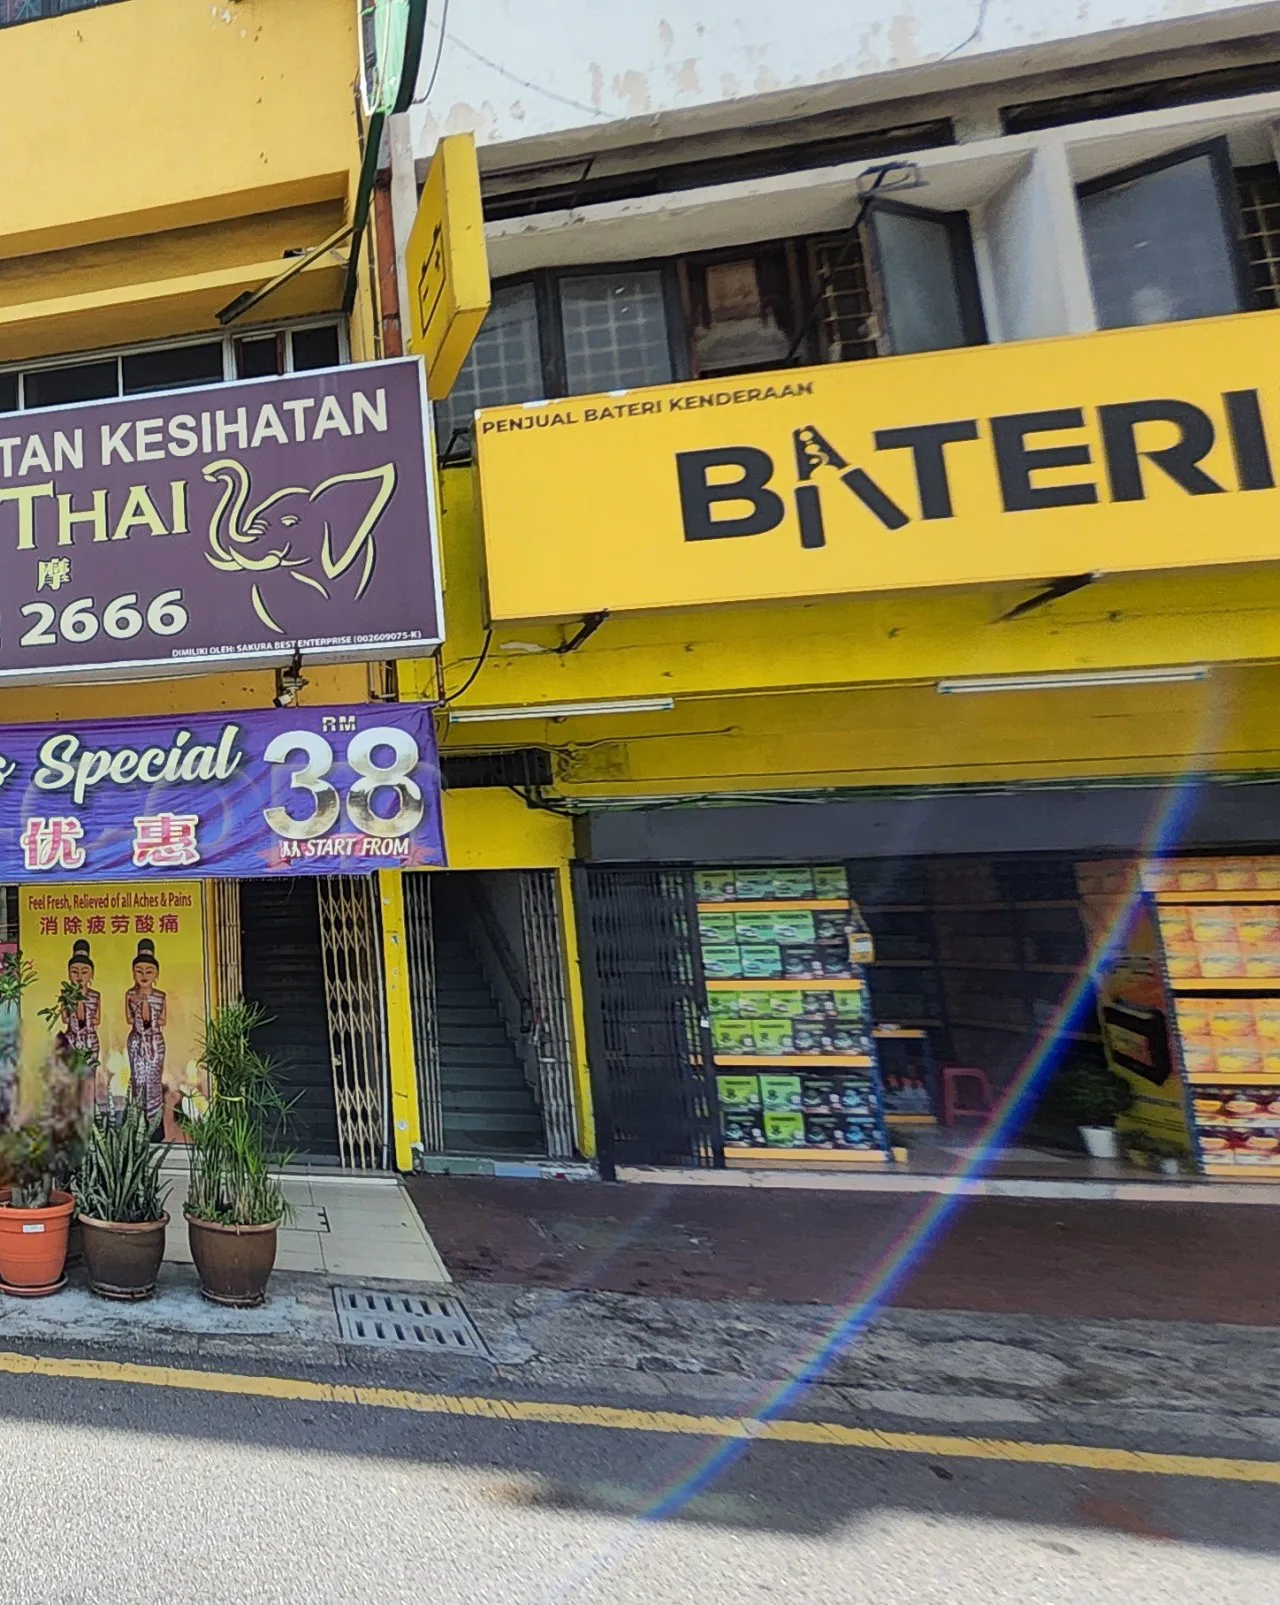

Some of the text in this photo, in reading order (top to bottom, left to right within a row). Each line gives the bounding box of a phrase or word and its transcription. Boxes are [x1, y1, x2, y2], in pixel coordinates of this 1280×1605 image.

[100, 388, 388, 466] KESIHATAN
[482, 381, 815, 435] PENJUAL BATERI KENDERAAN
[675, 387, 1276, 550] BATERI
[19, 589, 189, 649] 2666
[172, 648, 209, 659] DIMILIKI
[236, 642, 273, 653] SAKURA
[274, 639, 296, 650] BEST
[297, 635, 352, 649] ENTERPRISE
[322, 715, 357, 732] RM
[34, 724, 243, 804] Special
[263, 726, 425, 840] 38
[304, 837, 356, 857] START
[362, 837, 410, 856] FROM
[28, 892, 192, 911] Feel Fresh, Relieved of all Aches & Pains
[39, 914, 180, 936] 消除疲劳酸痛
